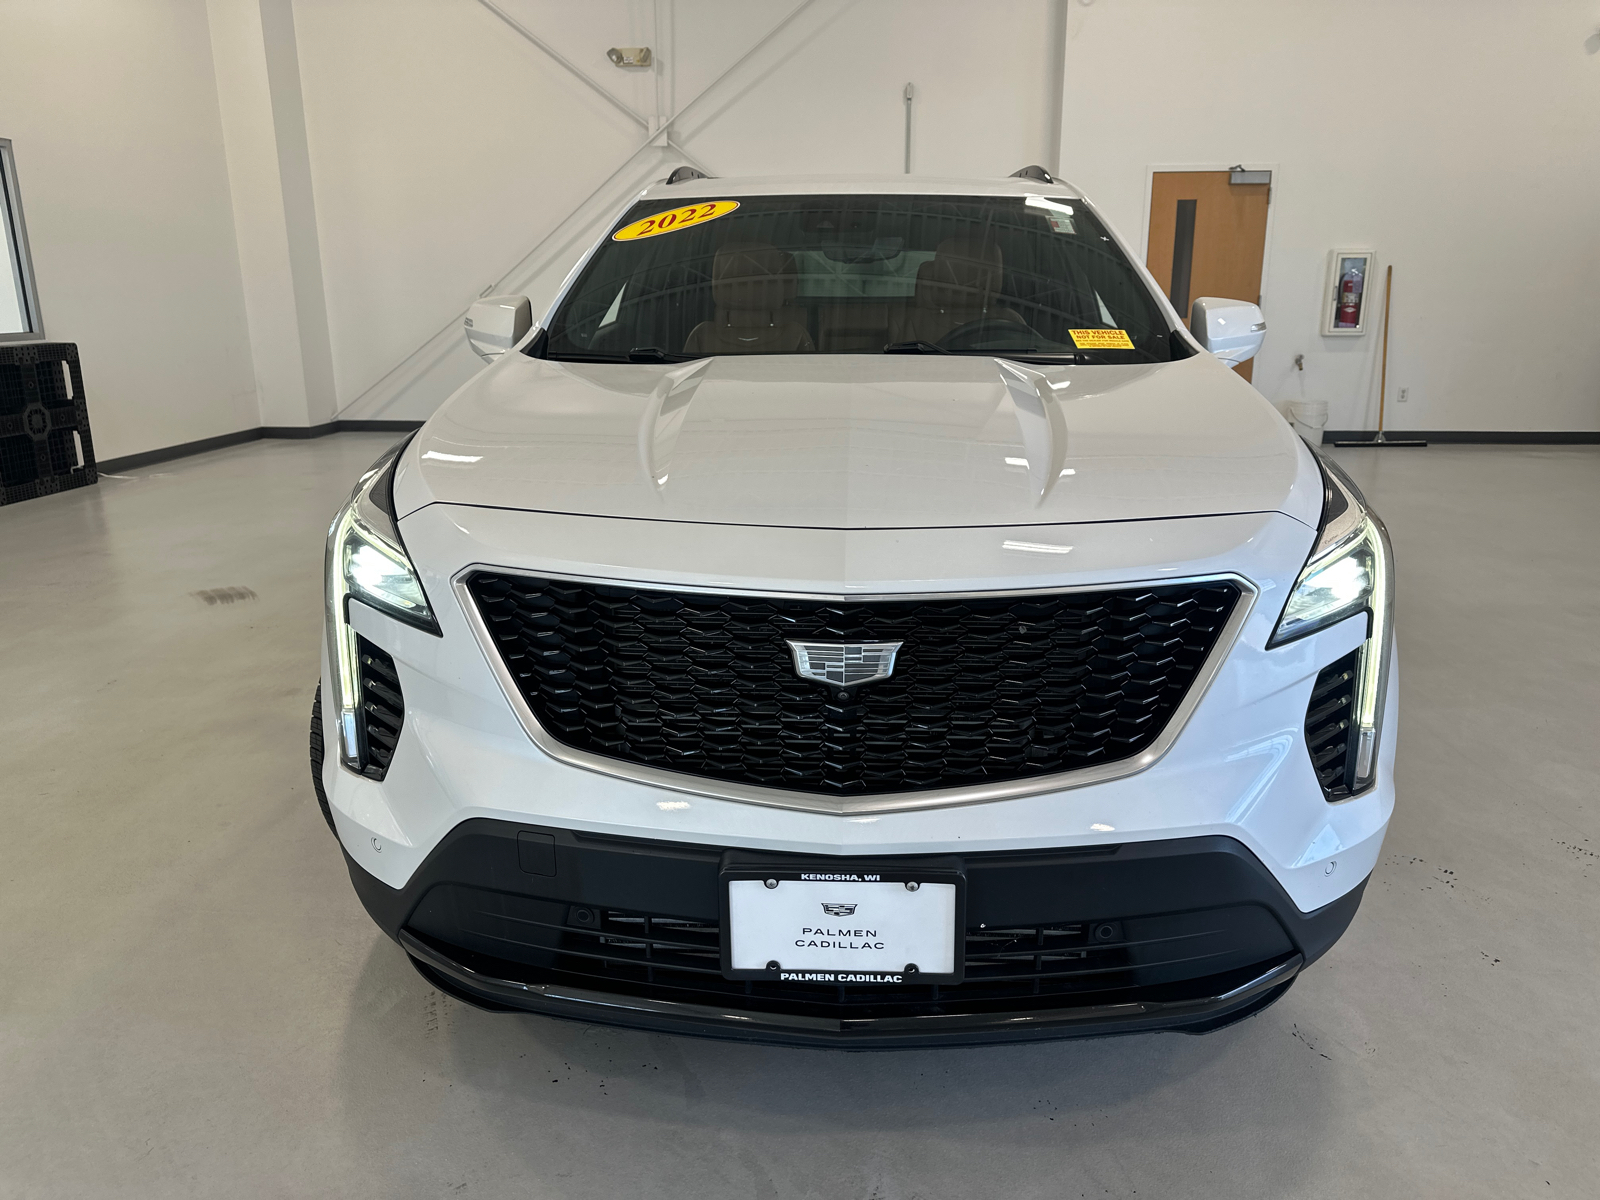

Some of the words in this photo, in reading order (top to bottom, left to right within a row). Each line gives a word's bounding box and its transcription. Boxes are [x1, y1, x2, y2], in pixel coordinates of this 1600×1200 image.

[636, 203, 717, 237] 2022
[800, 873, 862, 882] KENOSHA,
[863, 874, 880, 882] WI
[802, 927, 877, 938] PALMEN
[794, 939, 885, 950] CADILLAC
[780, 973, 835, 981] PALMEN
[837, 973, 903, 983] CADILLAC
